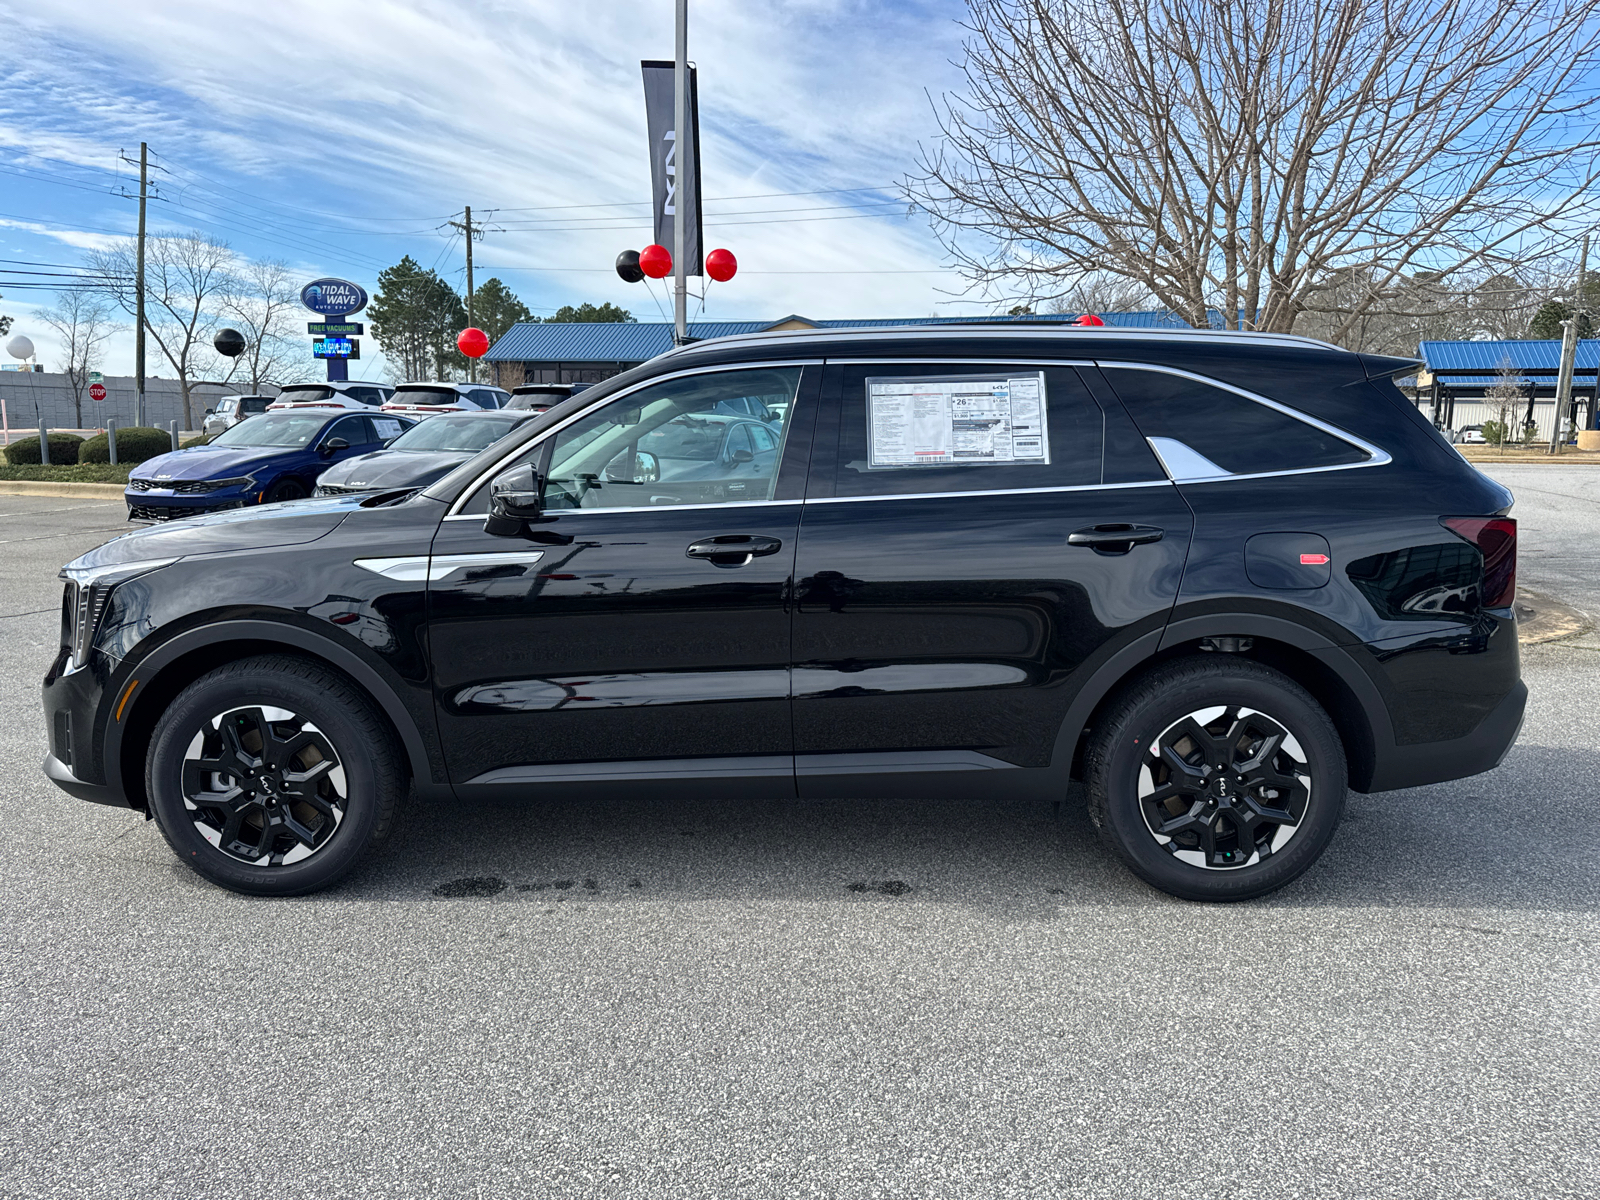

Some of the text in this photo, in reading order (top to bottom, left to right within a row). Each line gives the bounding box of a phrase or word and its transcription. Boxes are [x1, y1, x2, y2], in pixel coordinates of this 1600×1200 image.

[322, 285, 350, 295] TIDAL
[326, 295, 356, 305] WAVE
[309, 324, 355, 332] FREE VACUUMS
[90, 389, 106, 397] STOP
[956, 398, 967, 406] 26
[260, 776, 272, 794] KIA
